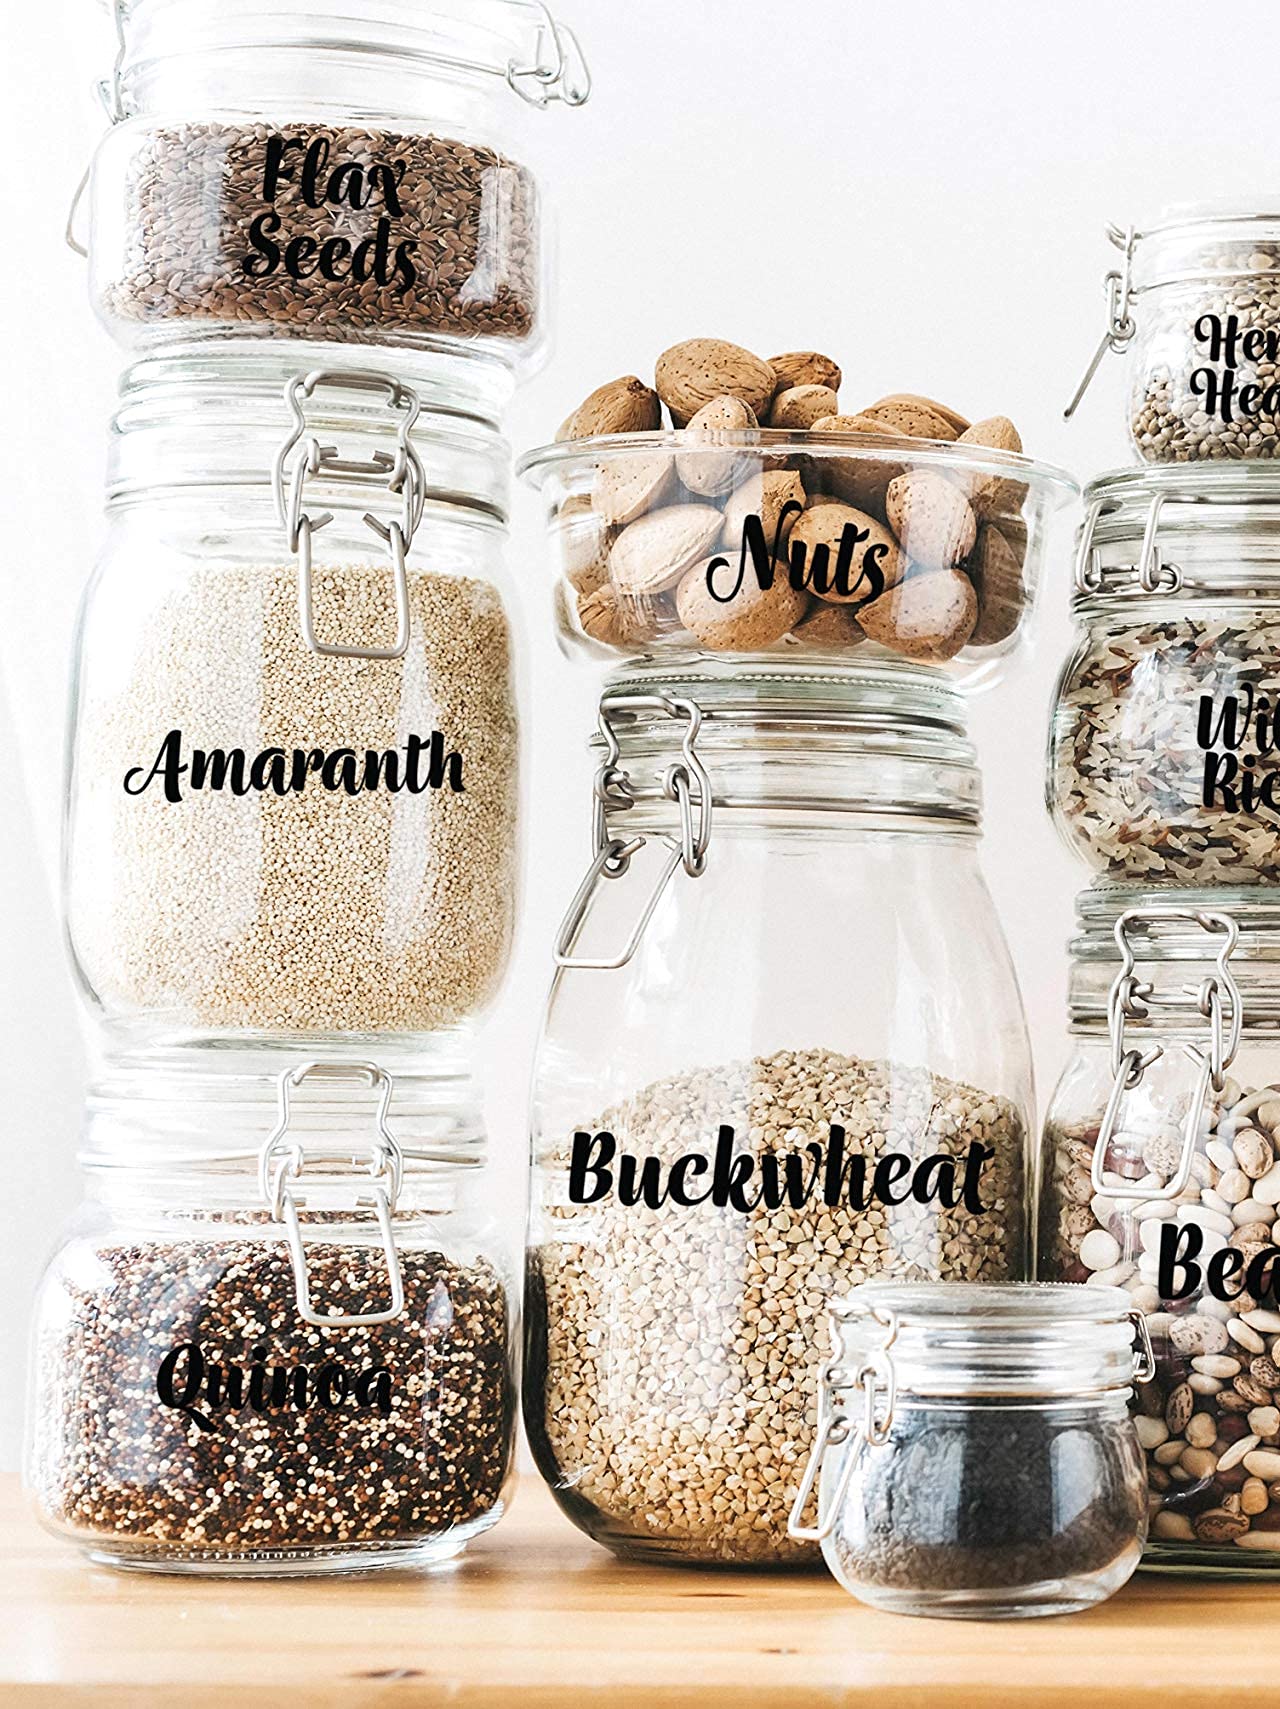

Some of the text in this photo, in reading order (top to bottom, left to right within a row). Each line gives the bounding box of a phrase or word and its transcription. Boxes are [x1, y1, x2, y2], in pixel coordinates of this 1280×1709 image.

[262, 136, 406, 217] Flax
[243, 211, 417, 291] Seeds
[706, 500, 889, 602] Nuts
[123, 729, 466, 803] Amaranth
[568, 1124, 994, 1214] Buckwheat
[156, 1343, 393, 1433] Quinoa
